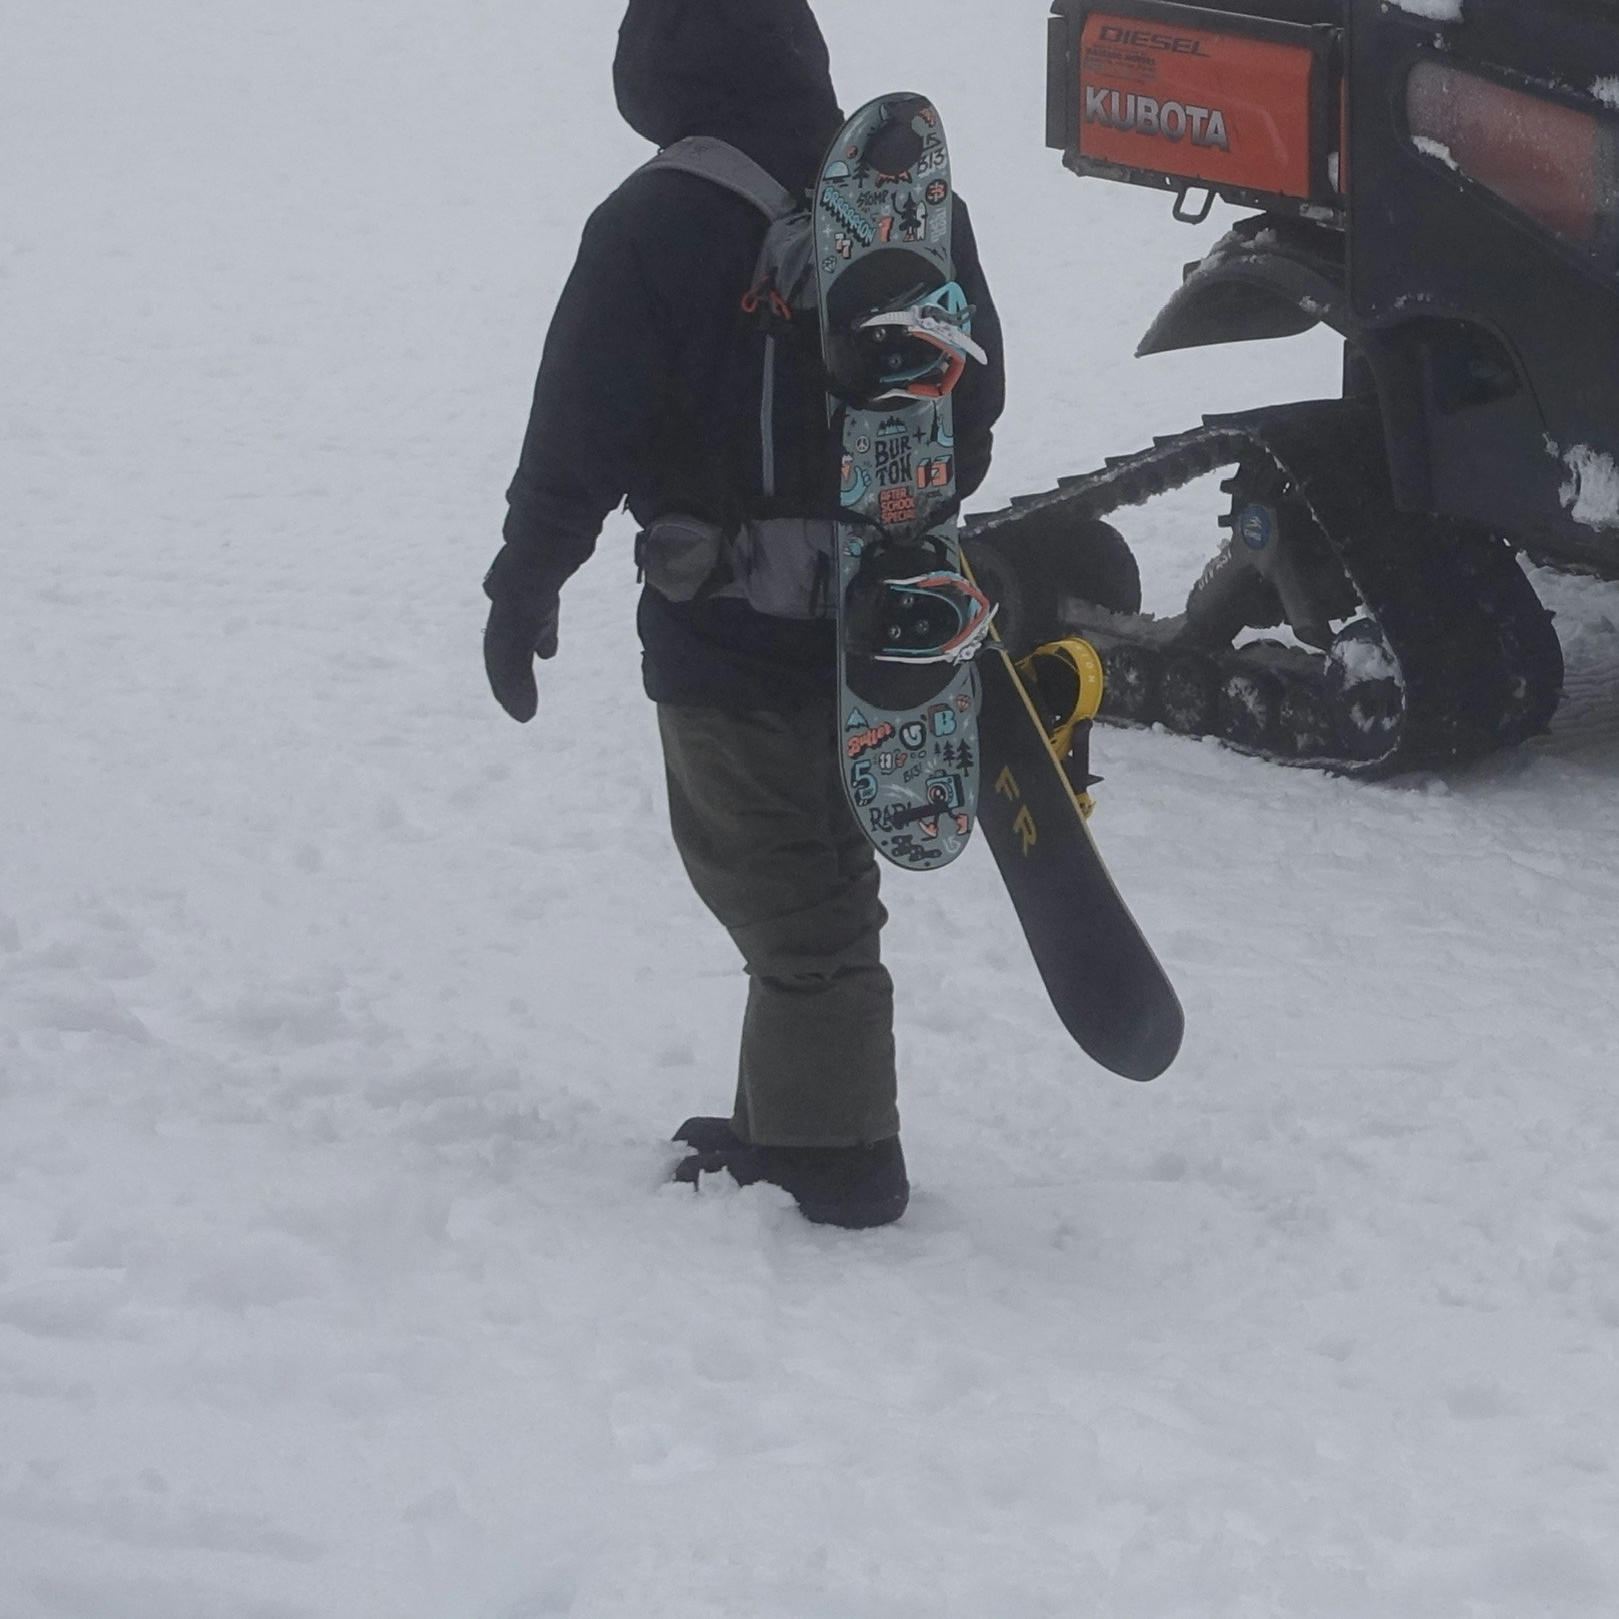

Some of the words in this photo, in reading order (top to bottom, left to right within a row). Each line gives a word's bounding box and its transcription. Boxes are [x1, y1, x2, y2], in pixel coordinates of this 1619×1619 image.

[1099, 26, 1211, 58] DIESEL
[1086, 85, 1231, 153] KUBOTA
[875, 435, 912, 468] BUR
[875, 453, 913, 486] TON
